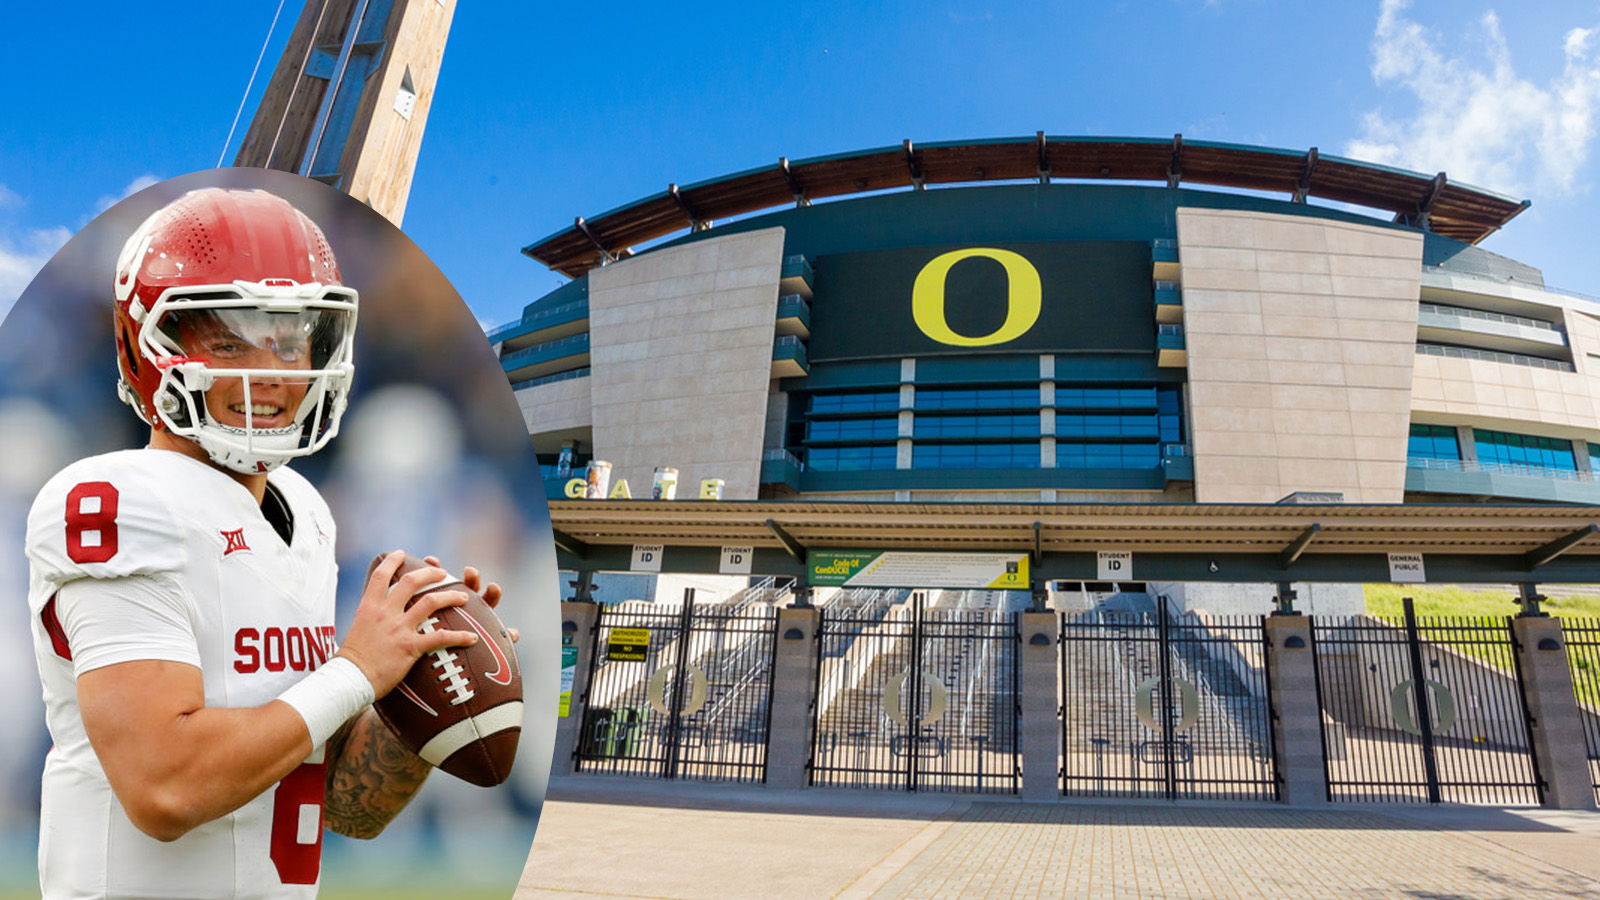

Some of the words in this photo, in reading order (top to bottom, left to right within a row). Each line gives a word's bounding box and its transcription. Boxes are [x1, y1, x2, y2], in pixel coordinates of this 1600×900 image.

[911, 247, 1042, 347] O
[564, 478, 720, 500] GATE
[65, 481, 119, 564] 8
[220, 527, 251, 555] XII
[641, 552, 653, 562] ID
[730, 554, 742, 564] ID
[1108, 560, 1121, 570] ID
